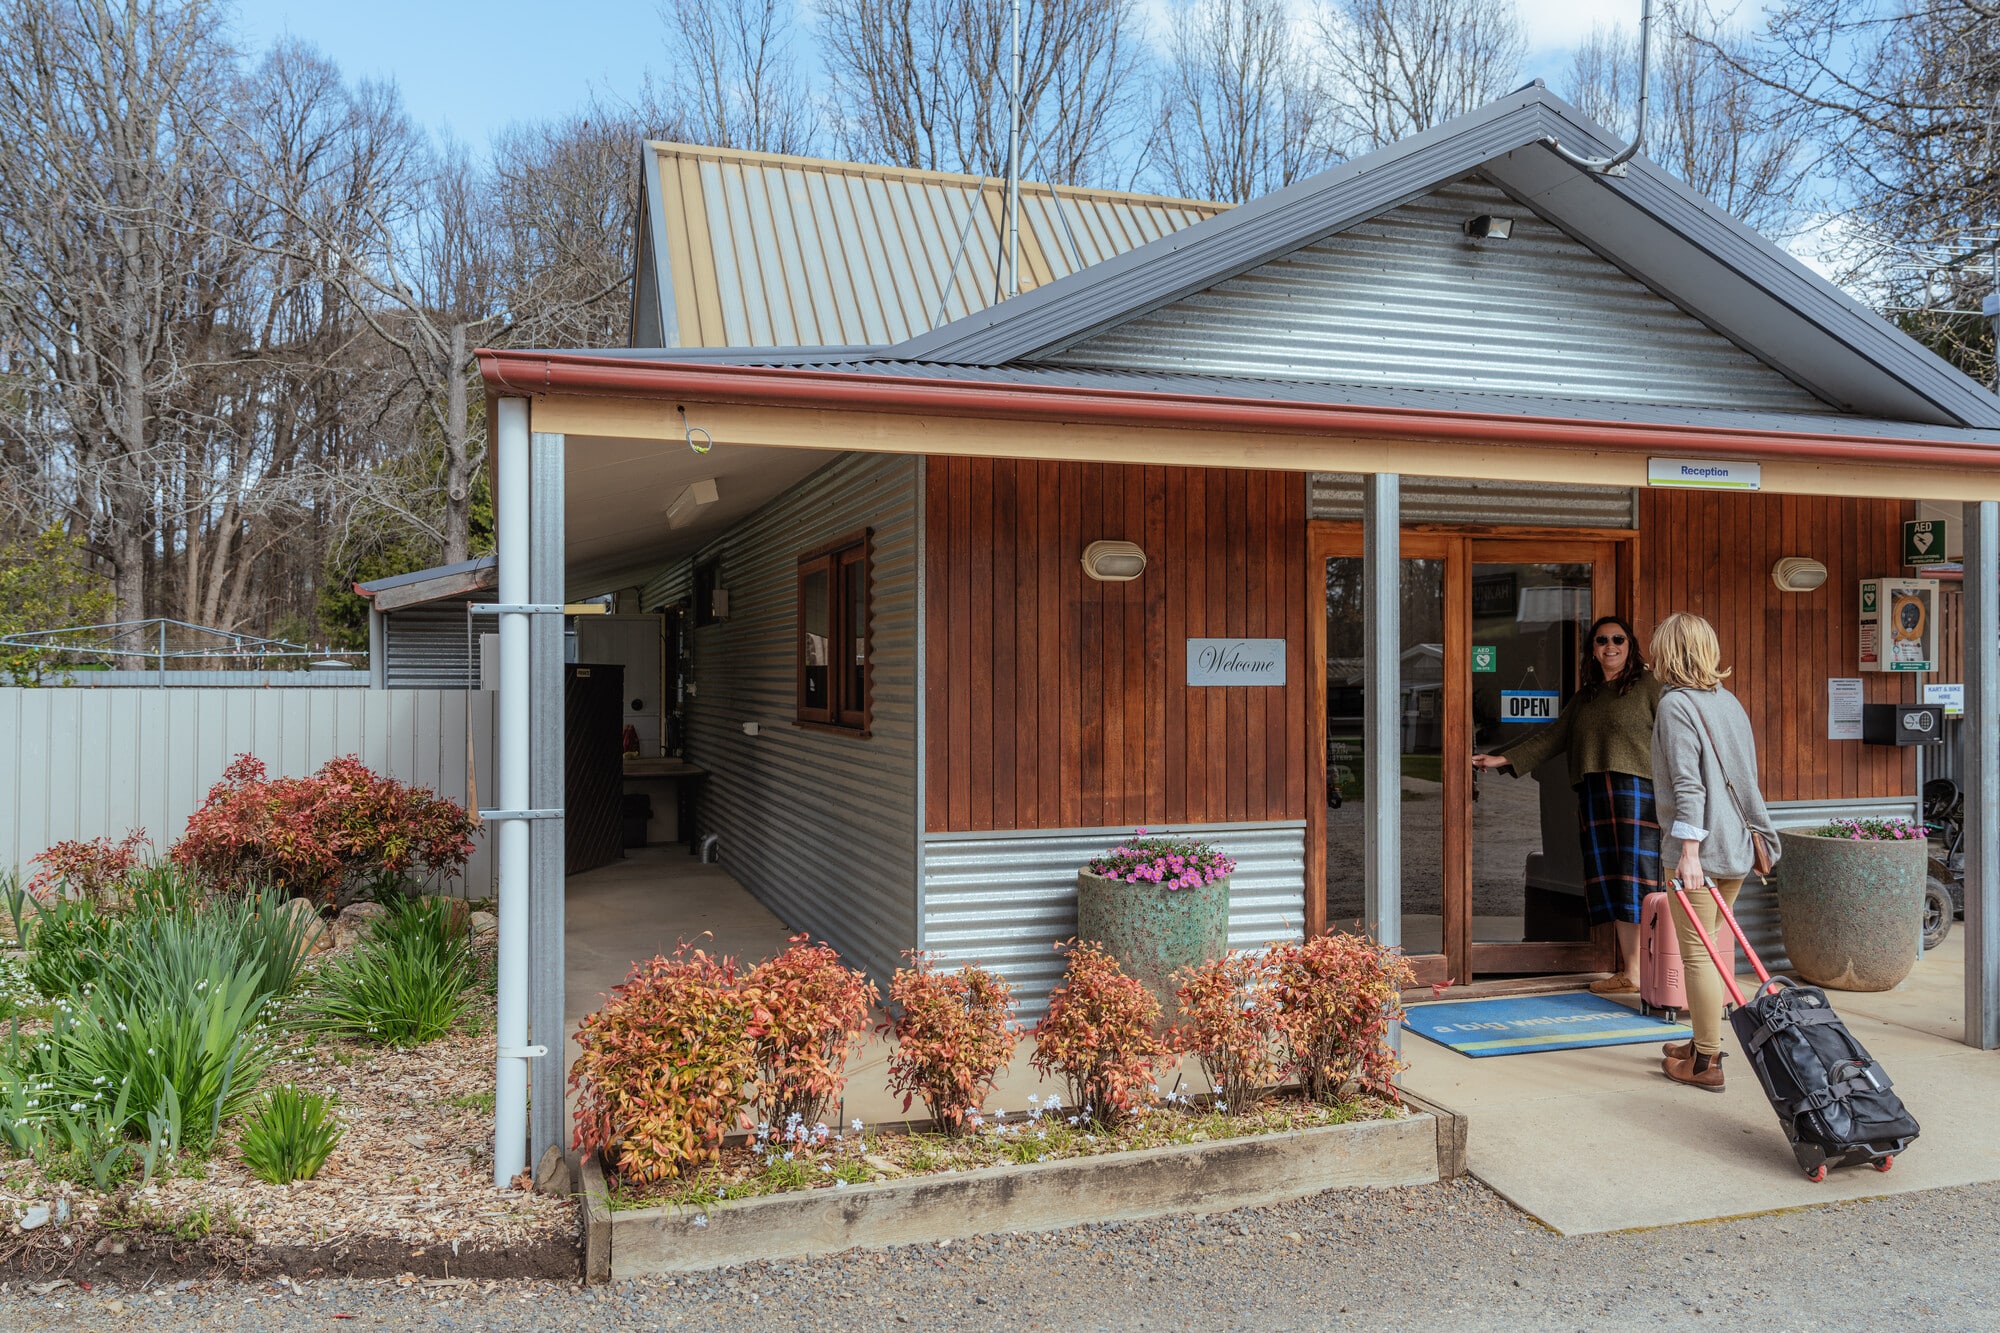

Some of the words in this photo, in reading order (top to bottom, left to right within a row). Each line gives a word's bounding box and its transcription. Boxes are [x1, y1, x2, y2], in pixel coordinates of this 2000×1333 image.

[1681, 466, 1729, 477] Reception
[1914, 522, 1932, 532] AED
[1199, 643, 1275, 673] Welcome
[1510, 697, 1550, 717] OPEN
[1433, 1025, 1456, 1033] a
[1454, 1021, 1510, 1032] big
[1508, 1011, 1633, 1027] welcome
